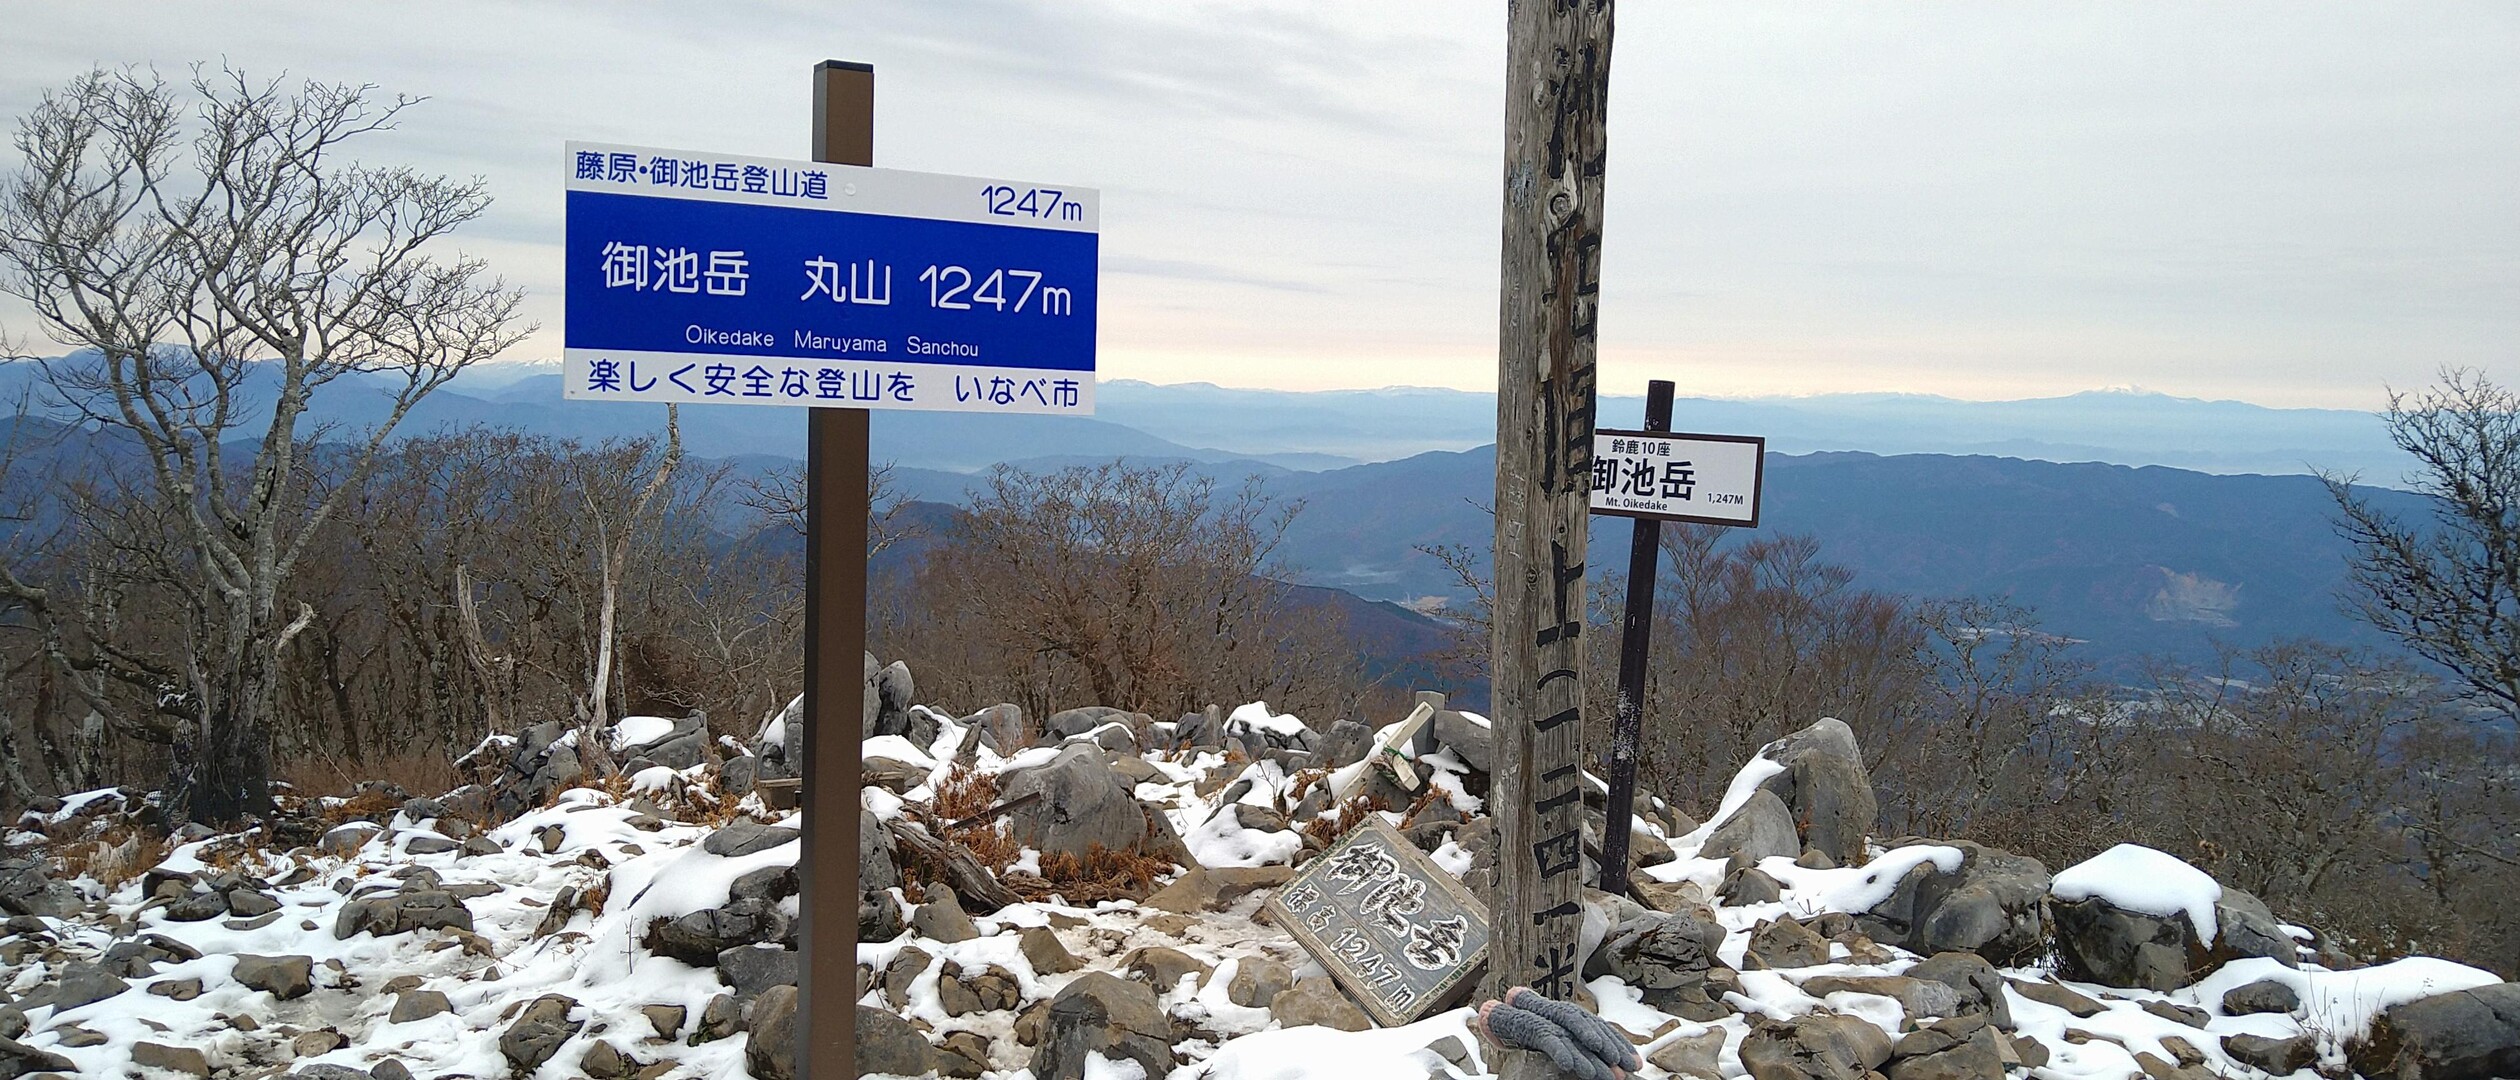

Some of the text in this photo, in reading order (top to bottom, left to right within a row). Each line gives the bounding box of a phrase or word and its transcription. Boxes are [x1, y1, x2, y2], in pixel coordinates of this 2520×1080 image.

[980, 185, 1083, 222] 1247m
[600, 241, 1072, 316] 御池岳 丸山 1247m
[685, 324, 979, 357] Oikedake Maruyama Sanchou
[587, 359, 1080, 408] 楽しく安全な登山を いなべ市
[1605, 496, 1668, 511] Mt. Oikedake
[1707, 492, 1744, 505] 1,247M
[1325, 841, 1469, 970] 御池岳
